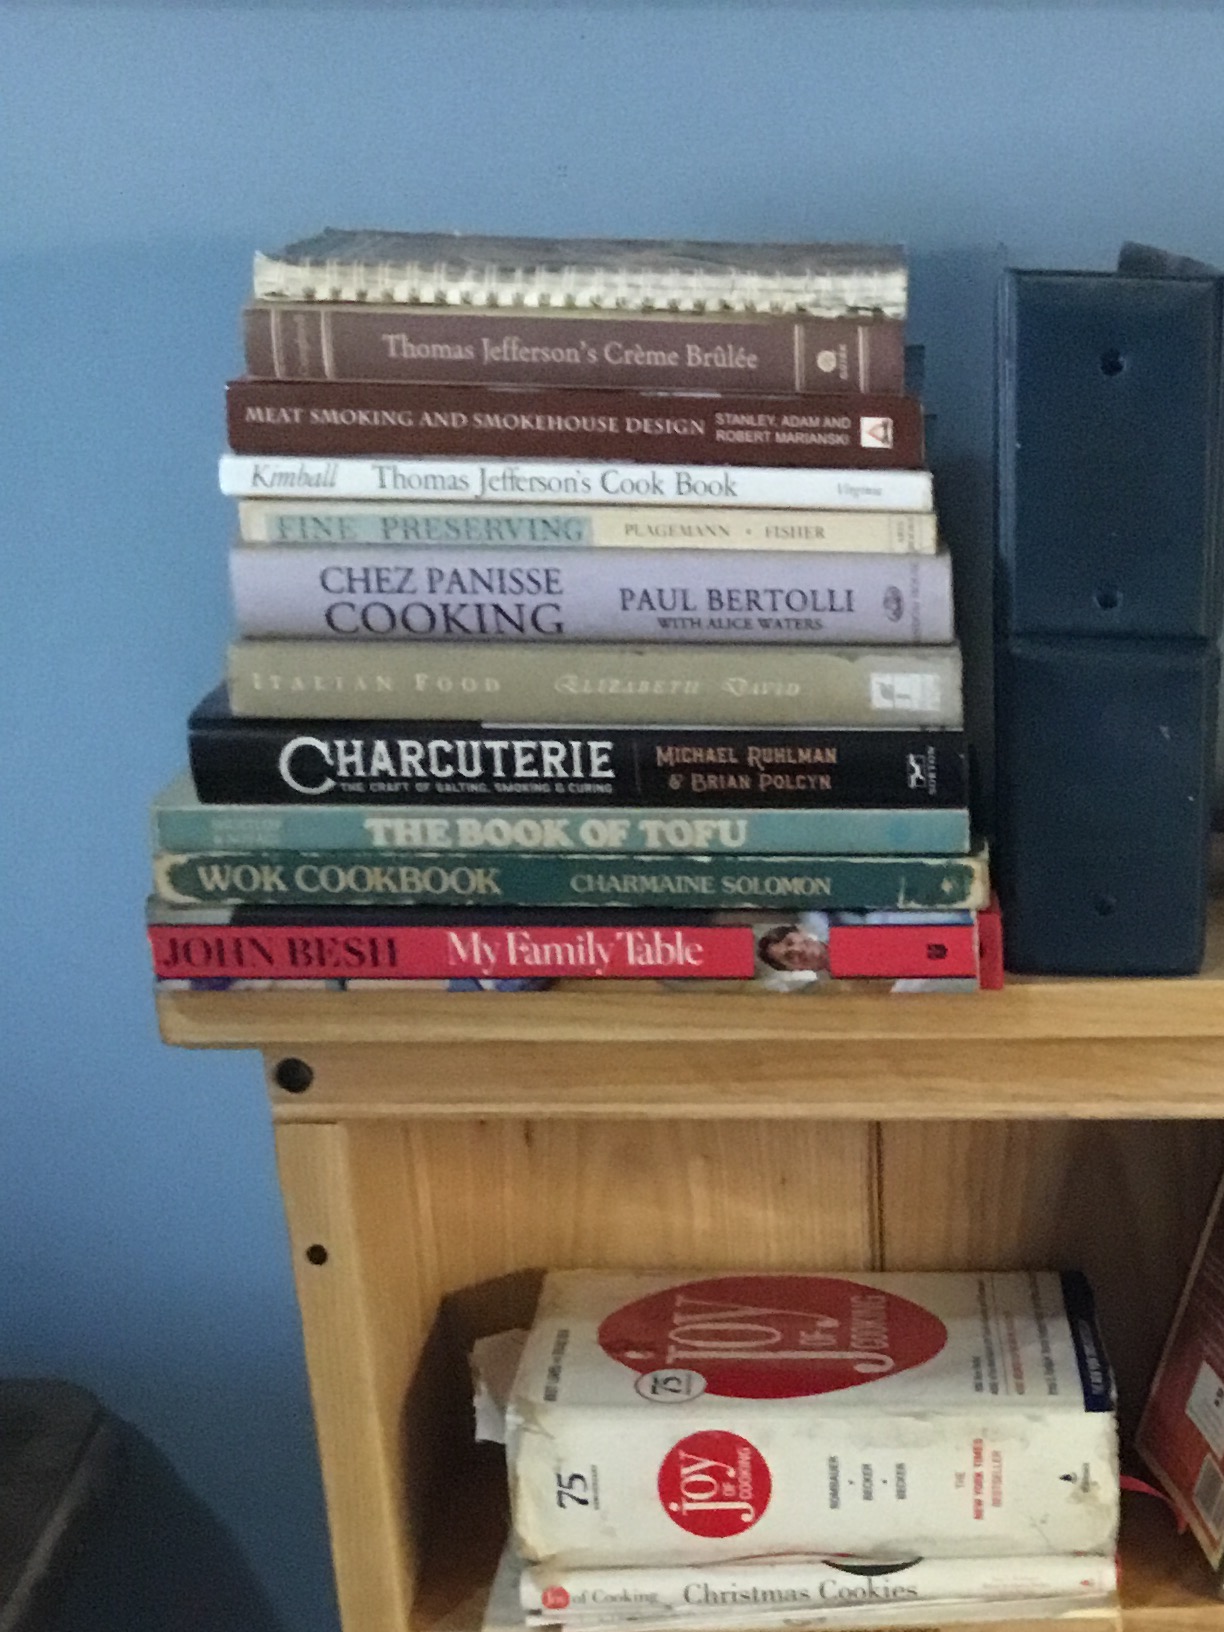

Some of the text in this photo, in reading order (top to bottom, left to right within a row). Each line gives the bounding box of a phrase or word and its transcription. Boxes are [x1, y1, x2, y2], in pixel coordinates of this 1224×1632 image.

[382, 333, 758, 368] Thomas Jefferson's Crème Brûlée
[246, 406, 706, 435] MEAT SMOKING AND SMOKEHOUSE DESIGN
[715, 429, 850, 446] ROBERT MARIANSKI
[251, 464, 738, 499] Kimball Thomas Jefferson's Cook Book
[278, 515, 826, 540] FINE PRESERVING PLAGEMANN FISHER
[319, 566, 564, 596] CHEZ PANISSE
[619, 587, 855, 614] PAUL BERTOLLI
[325, 602, 565, 636] COOKING
[657, 616, 823, 632] WITH ALICE WATERS
[279, 736, 616, 795] CHARCUTERIE
[656, 745, 837, 771] MICHAEL RUHLMAN
[341, 781, 363, 793] THE
[369, 781, 412, 794] CRAFT
[416, 782, 432, 794] OF
[495, 782, 552, 794] SMOKING
[568, 782, 613, 795] CURING
[668, 773, 833, 792] & BRIAN POLCYN
[364, 817, 749, 849] THE BOOK OF TOFU
[199, 866, 832, 896] WOK COOKBOOK CHARMAINE SOLOMON
[162, 931, 705, 976] JOHN BESH My Family Table
[736, 1446, 753, 1499] COOKING
[556, 1472, 589, 1508] 75
[592, 1589, 659, 1605] Cooking
[683, 1582, 809, 1605] Christmas
[819, 1578, 918, 1602] Cookies
